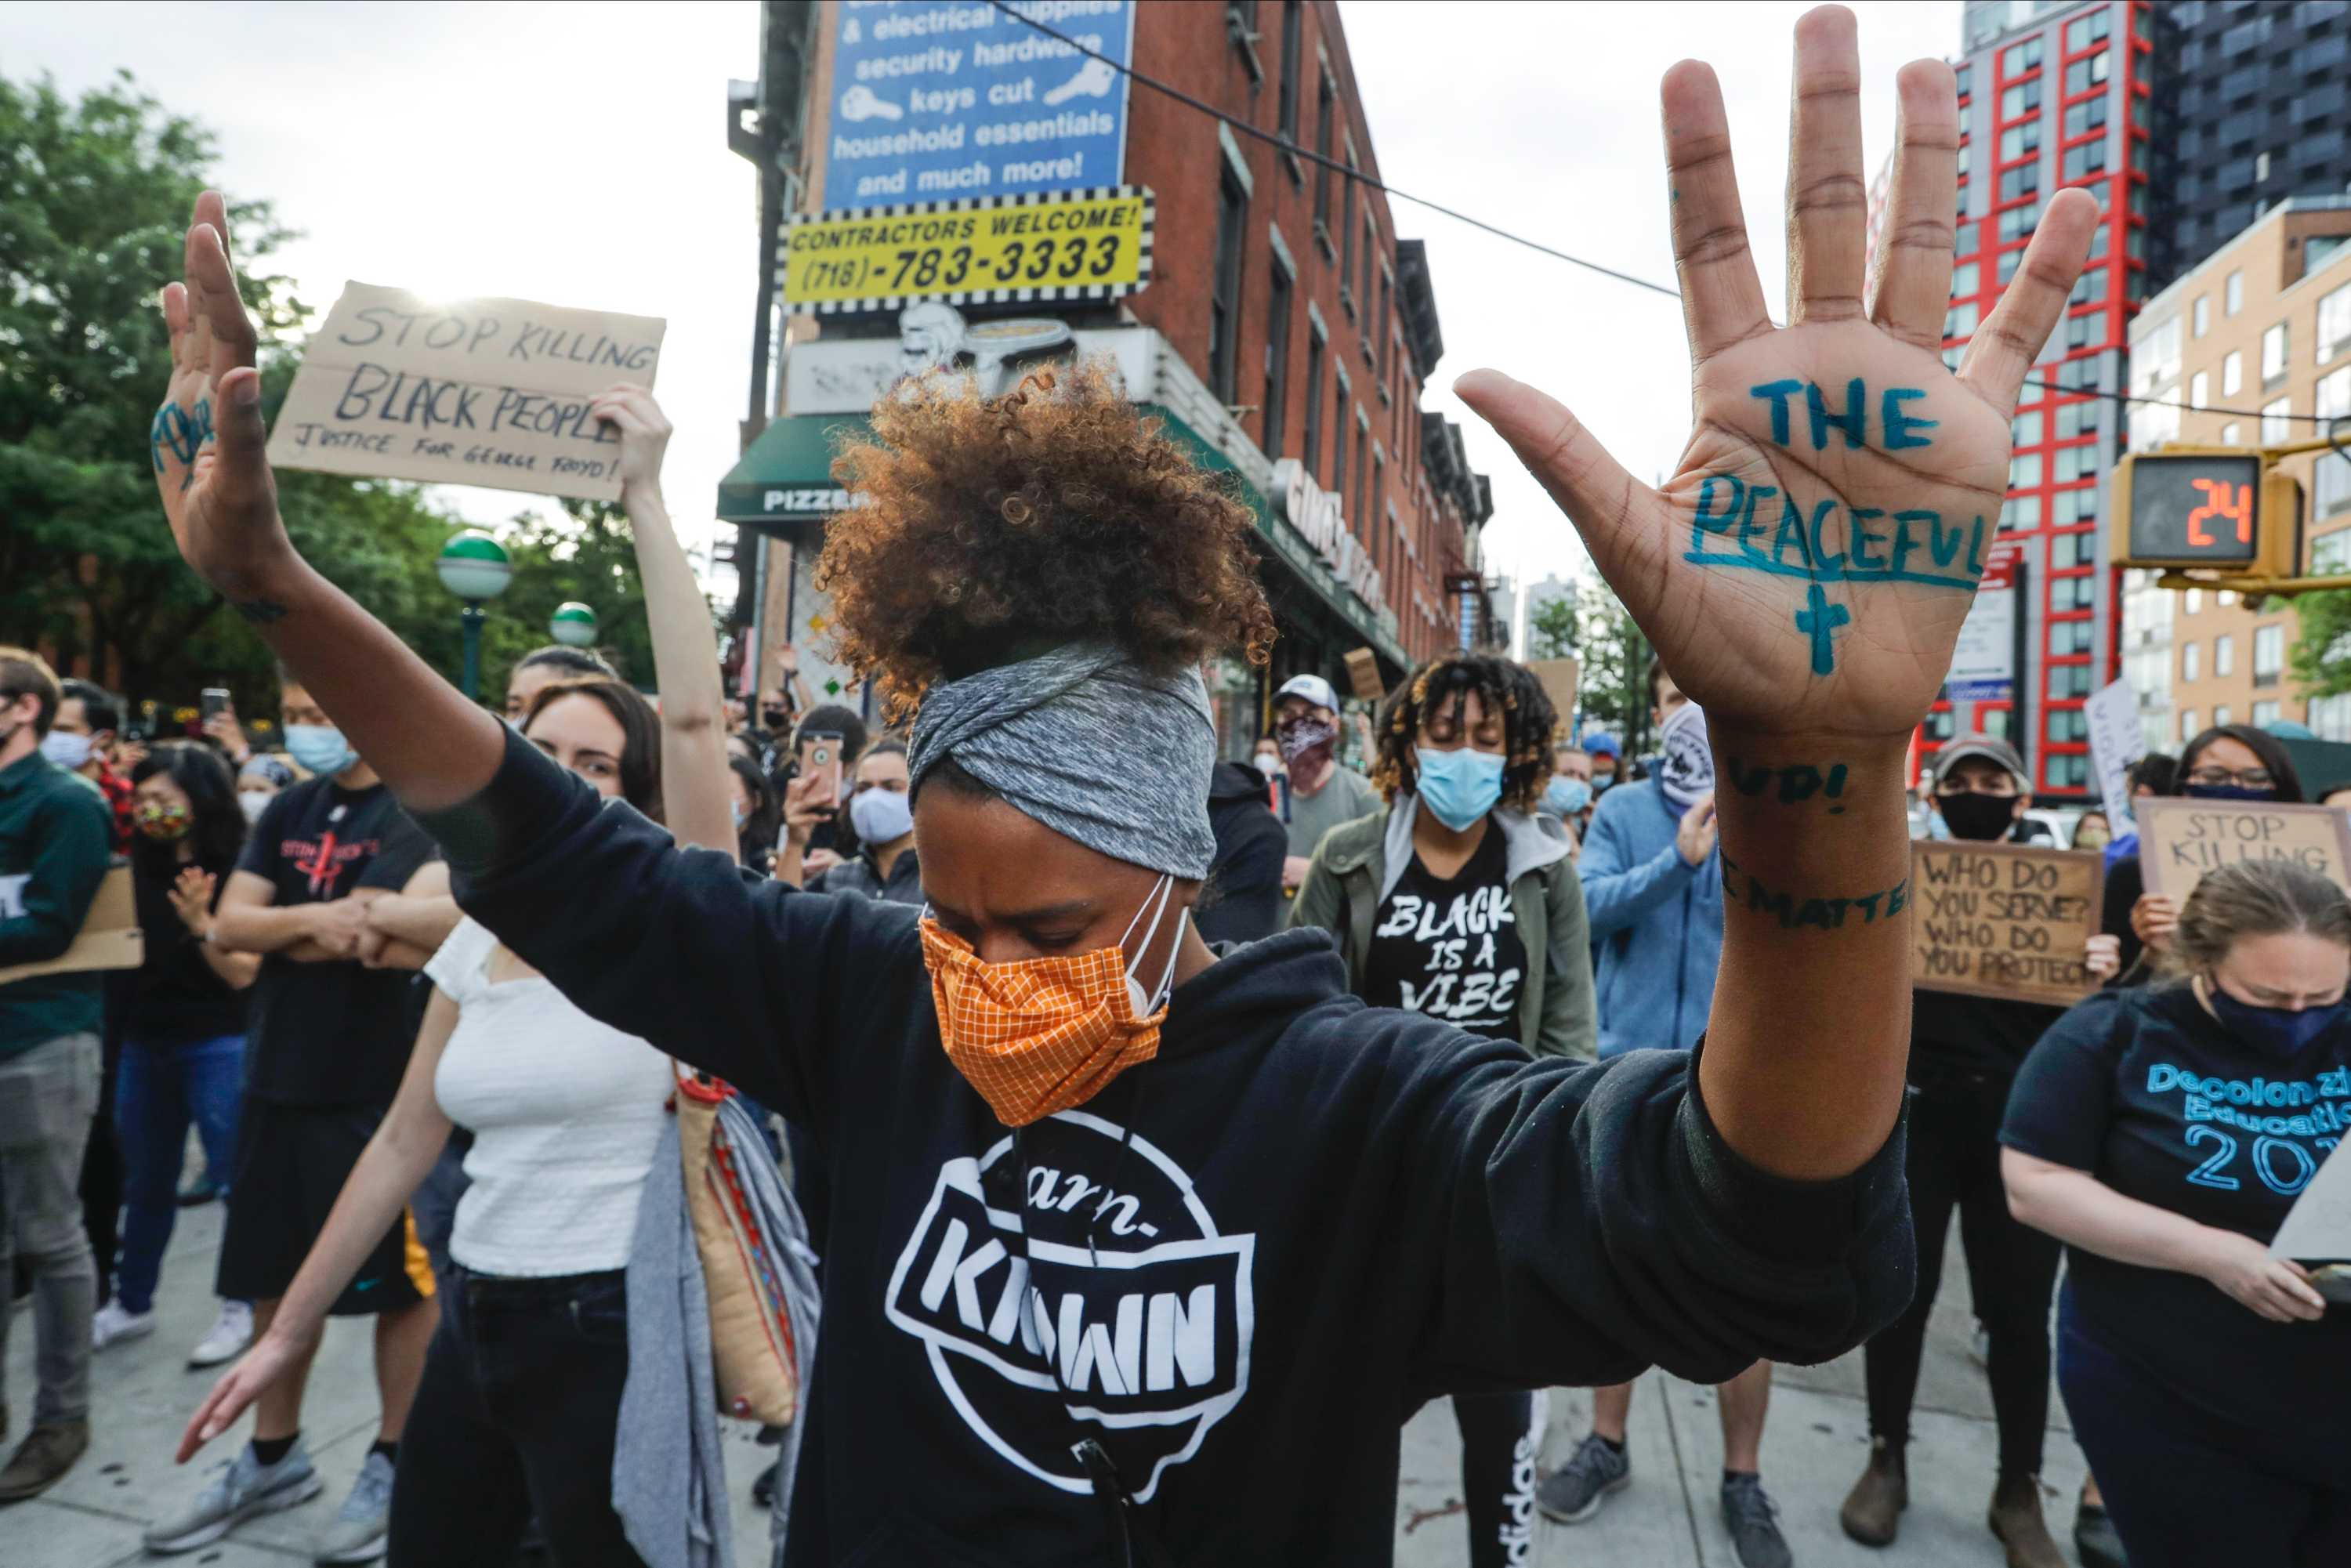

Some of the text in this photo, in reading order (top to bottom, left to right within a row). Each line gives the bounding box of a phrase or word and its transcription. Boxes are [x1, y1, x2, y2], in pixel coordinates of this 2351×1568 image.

[842, 19, 861, 44] &
[874, 3, 996, 41] electrical
[856, 34, 1103, 80] security hardware
[910, 78, 1035, 114] keys cut
[834, 110, 1114, 159] household essentials
[856, 151, 1084, 196] and much more!
[792, 205, 1139, 253] CONTRACTORS WELCOME!
[802, 234, 1121, 291] (718)-783-3333
[339, 306, 657, 371] STOP KILLING
[336, 362, 476, 429] BLACK
[1750, 377, 1940, 451] THE
[294, 422, 392, 454] JUSTICE
[413, 437, 452, 459] FOR
[1690, 474, 1985, 576] PEACEFUL
[2188, 478, 2252, 545] 24
[2186, 814, 2286, 842] STOP
[1923, 855, 2058, 889] WHO DO
[1377, 885, 1515, 942] BLACK
[1749, 878, 1910, 929] MATTE
[1923, 889, 2091, 924] YOU SERVE?
[1425, 932, 1497, 972] IS A
[1925, 921, 2050, 953] WHO DO
[1919, 947, 1971, 976] YOU
[1400, 968, 1520, 1018] VIBE
[2185, 1124, 2342, 1196] 20
[1498, 1434, 1536, 1568] didas
